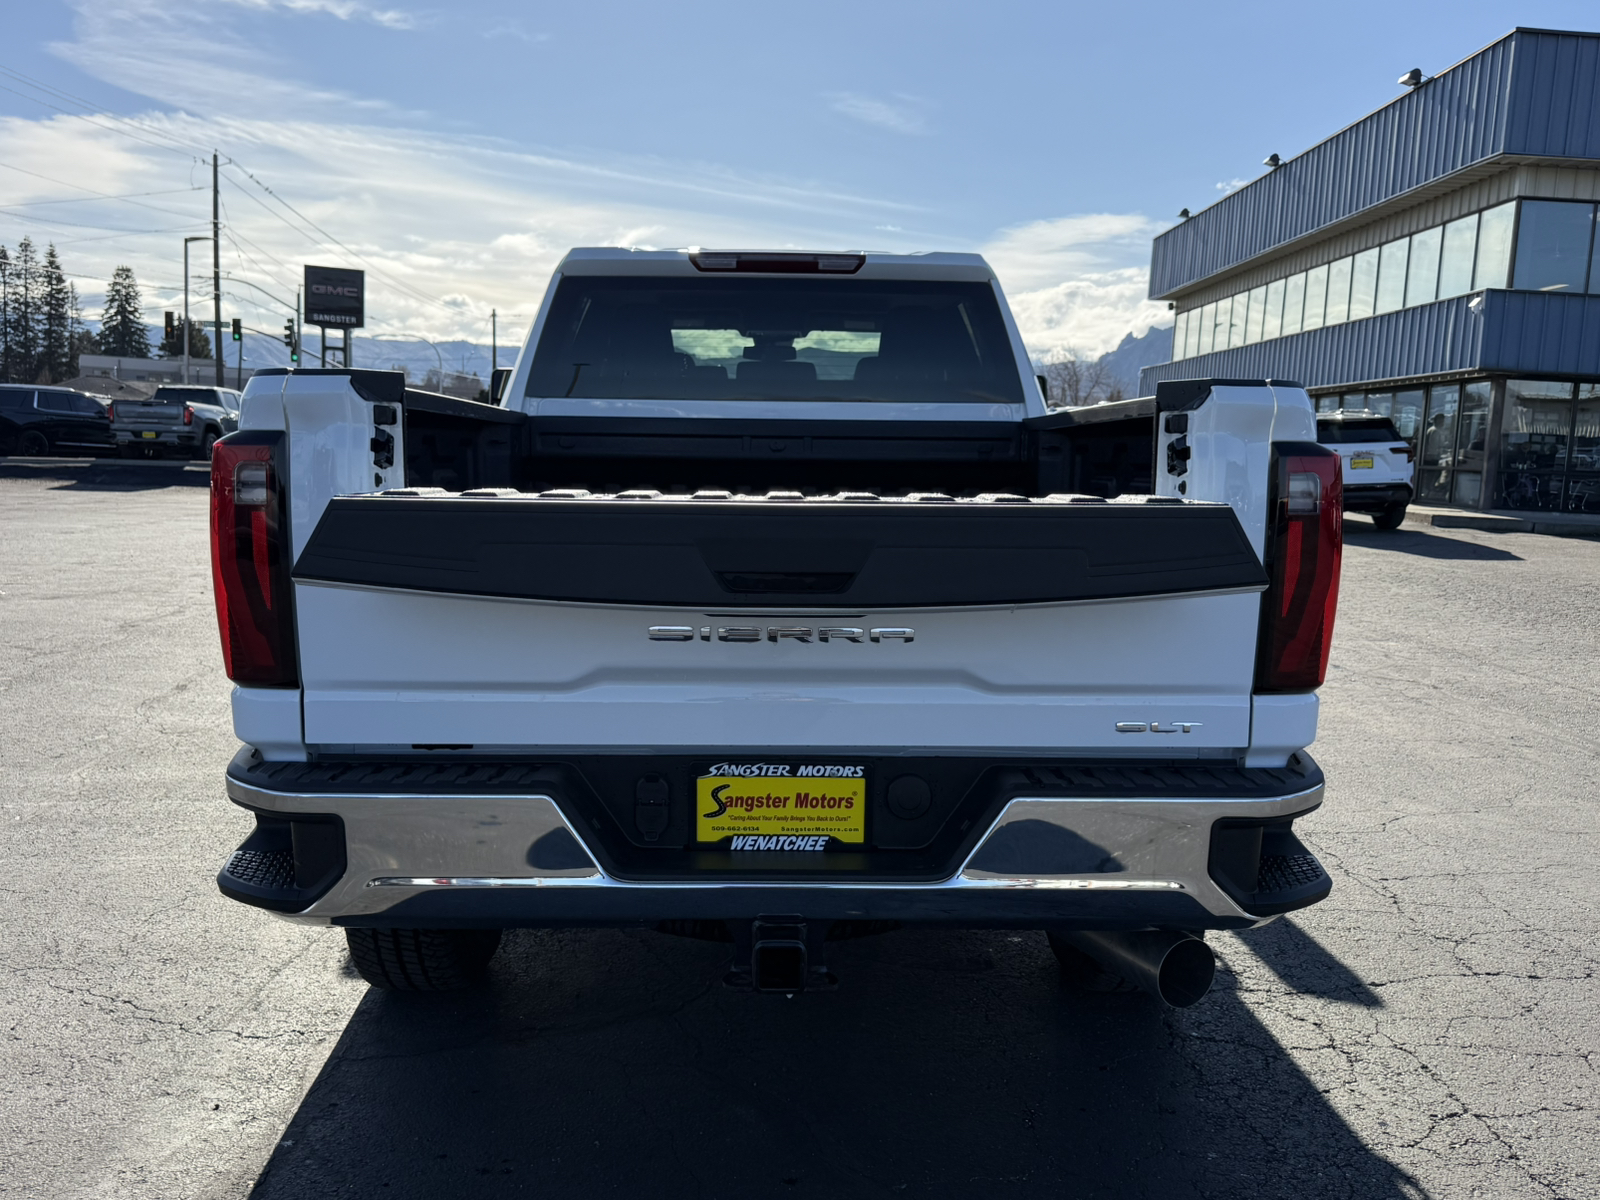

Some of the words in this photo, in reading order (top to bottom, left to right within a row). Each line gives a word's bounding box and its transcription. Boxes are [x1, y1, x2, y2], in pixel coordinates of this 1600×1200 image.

[312, 285, 358, 297] GMC
[313, 313, 357, 324] SANGSTER
[648, 625, 915, 644] SIERRA
[1115, 721, 1203, 734] SLT
[698, 762, 793, 778] SANGSTER
[796, 765, 865, 777] MOTORS
[702, 784, 790, 818] Sangster
[773, 815, 789, 823] Family
[790, 815, 806, 823] Brings
[730, 835, 830, 851] WENATCHEE
